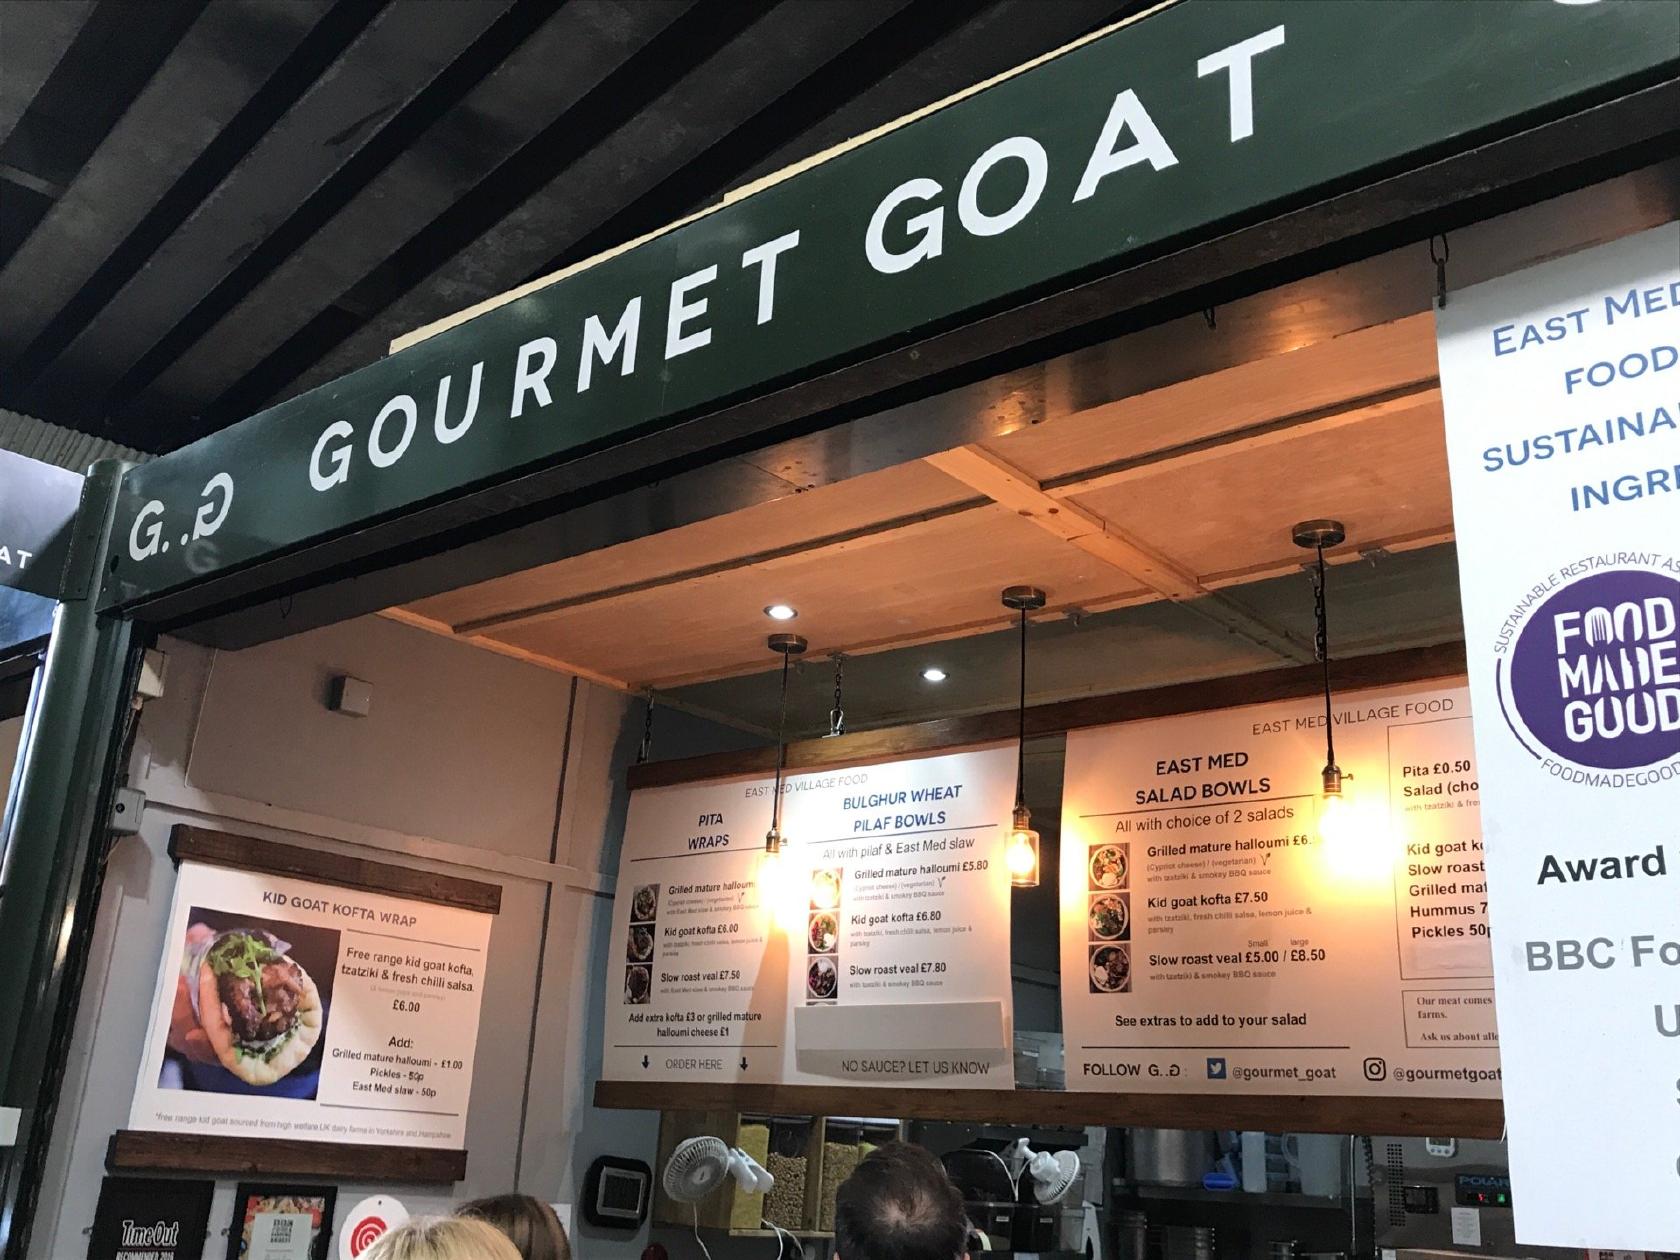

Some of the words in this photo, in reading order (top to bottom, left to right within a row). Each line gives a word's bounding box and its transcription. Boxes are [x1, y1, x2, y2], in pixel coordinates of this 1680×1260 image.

[309, 229, 799, 492] GOURMET
[865, 24, 1285, 274] GOAT
[1493, 308, 1589, 357] EAST
[1565, 345, 1679, 394] FOOD
[1483, 402, 1680, 472] SUSTAINA
[1494, 574, 1561, 654] SUSTAINABLE
[1560, 551, 1661, 581] RESTAURANT
[1553, 596, 1677, 655] FOOD
[1557, 640, 1680, 699] MADE
[1253, 719, 1290, 735] EAST
[1296, 715, 1328, 730] MED
[1333, 705, 1400, 725] VILLAGE
[1406, 698, 1453, 716] FOOD
[1564, 688, 1680, 743] GOOD
[1156, 757, 1203, 775] EAST
[1208, 752, 1248, 769] MED
[1403, 766, 1429, 778] Pita
[1433, 760, 1471, 774] £0.50
[745, 787, 769, 798] EAST
[795, 780, 836, 792] VILLAGE
[838, 774, 868, 786] FOOD
[1136, 786, 1196, 804] SALAD
[1202, 778, 1271, 798] BOWLS
[1404, 782, 1442, 797] Salad
[1448, 780, 1478, 795] (cho
[844, 791, 906, 809] BULGHUR
[911, 785, 963, 803] WHEAT
[698, 813, 723, 827] PITA
[854, 817, 891, 832] PILAF
[895, 811, 945, 829] BOWLS
[1116, 821, 1131, 832] All
[1136, 817, 1161, 831] with
[1167, 815, 1211, 829] choice
[1216, 811, 1229, 824] of
[1234, 810, 1241, 822] 2
[1247, 806, 1294, 822] salads
[688, 834, 730, 850] WRAPS
[1147, 844, 1186, 857] Grilled
[1190, 842, 1231, 854] mature
[1235, 836, 1289, 850] halloumi
[1407, 843, 1430, 856] Kid
[1435, 841, 1466, 856] goat
[855, 869, 884, 879] Grilled
[886, 866, 917, 877] mature
[920, 862, 960, 874] halloumi
[962, 860, 988, 872] £5.80
[1229, 869, 1246, 877] BBQ
[1409, 864, 1442, 876] Slow
[1447, 861, 1485, 873] roast
[1537, 845, 1667, 885] Award
[1409, 883, 1456, 896] Grilled
[1148, 897, 1167, 908] Kid
[1171, 896, 1197, 909] goat
[1201, 893, 1231, 905] kofta
[1235, 891, 1268, 904] £7.50
[263, 891, 287, 905] KID
[291, 897, 329, 913] GOAT
[333, 904, 375, 921] KOFTA
[380, 912, 416, 927] WRAP
[1410, 905, 1475, 917] Hummus
[852, 915, 866, 924] Kid
[869, 914, 888, 926] goat
[891, 912, 914, 922] kofta
[916, 911, 941, 921] £6.80
[1412, 925, 1464, 938] Pickles
[1248, 939, 1268, 947] Small
[346, 947, 370, 960] Free
[374, 953, 402, 966] range
[406, 955, 420, 968] kid
[423, 960, 445, 972] goat
[1149, 955, 1178, 966] Slow
[1182, 954, 1213, 964] roast
[1216, 953, 1242, 964] veal
[1245, 951, 1278, 963] £5.00
[1283, 950, 1287, 962] /
[1291, 949, 1325, 961] £8.50
[1525, 936, 1616, 972] BBC
[341, 964, 378, 978] tzatziki
[382, 970, 389, 980] &
[393, 971, 417, 984] fresh
[421, 976, 445, 988] chilli
[850, 965, 871, 975] Slow
[874, 965, 897, 974] roast
[900, 963, 918, 973] veal
[921, 962, 946, 972] £7.80
[393, 1000, 420, 1012] £6.00
[1417, 997, 1435, 1005] Our
[1438, 997, 1461, 1005] meat
[628, 1012, 643, 1022] Add
[666, 1012, 684, 1022] kofta
[686, 1012, 695, 1021] £3
[697, 1013, 706, 1021] or
[708, 1012, 731, 1024] grilled
[734, 1012, 762, 1021] mature
[1115, 1015, 1136, 1027] See
[1140, 1016, 1176, 1026] extras
[1180, 1015, 1192, 1026] to
[1196, 1014, 1218, 1026] add
[1222, 1015, 1235, 1025] to
[1239, 1015, 1268, 1028] your
[1272, 1013, 1306, 1025] salad
[1418, 1011, 1447, 1019] farms.
[657, 1028, 689, 1037] halloumi
[691, 1027, 718, 1036] cheese
[720, 1027, 729, 1036] £1
[388, 1036, 414, 1048] Add:
[666, 1059, 696, 1069] ORDER
[699, 1059, 723, 1069] HERE
[842, 1060, 858, 1072] NO
[862, 1060, 905, 1073] SAUCE?
[909, 1061, 929, 1073] LET
[933, 1062, 949, 1074] US
[952, 1062, 990, 1075] KNOW
[1083, 1063, 1141, 1076] FOLLOW
[1232, 1066, 1336, 1081] @gourmet_goat
[1392, 1067, 1502, 1083] @gourmetgoat
[154, 1221, 179, 1247] Out
